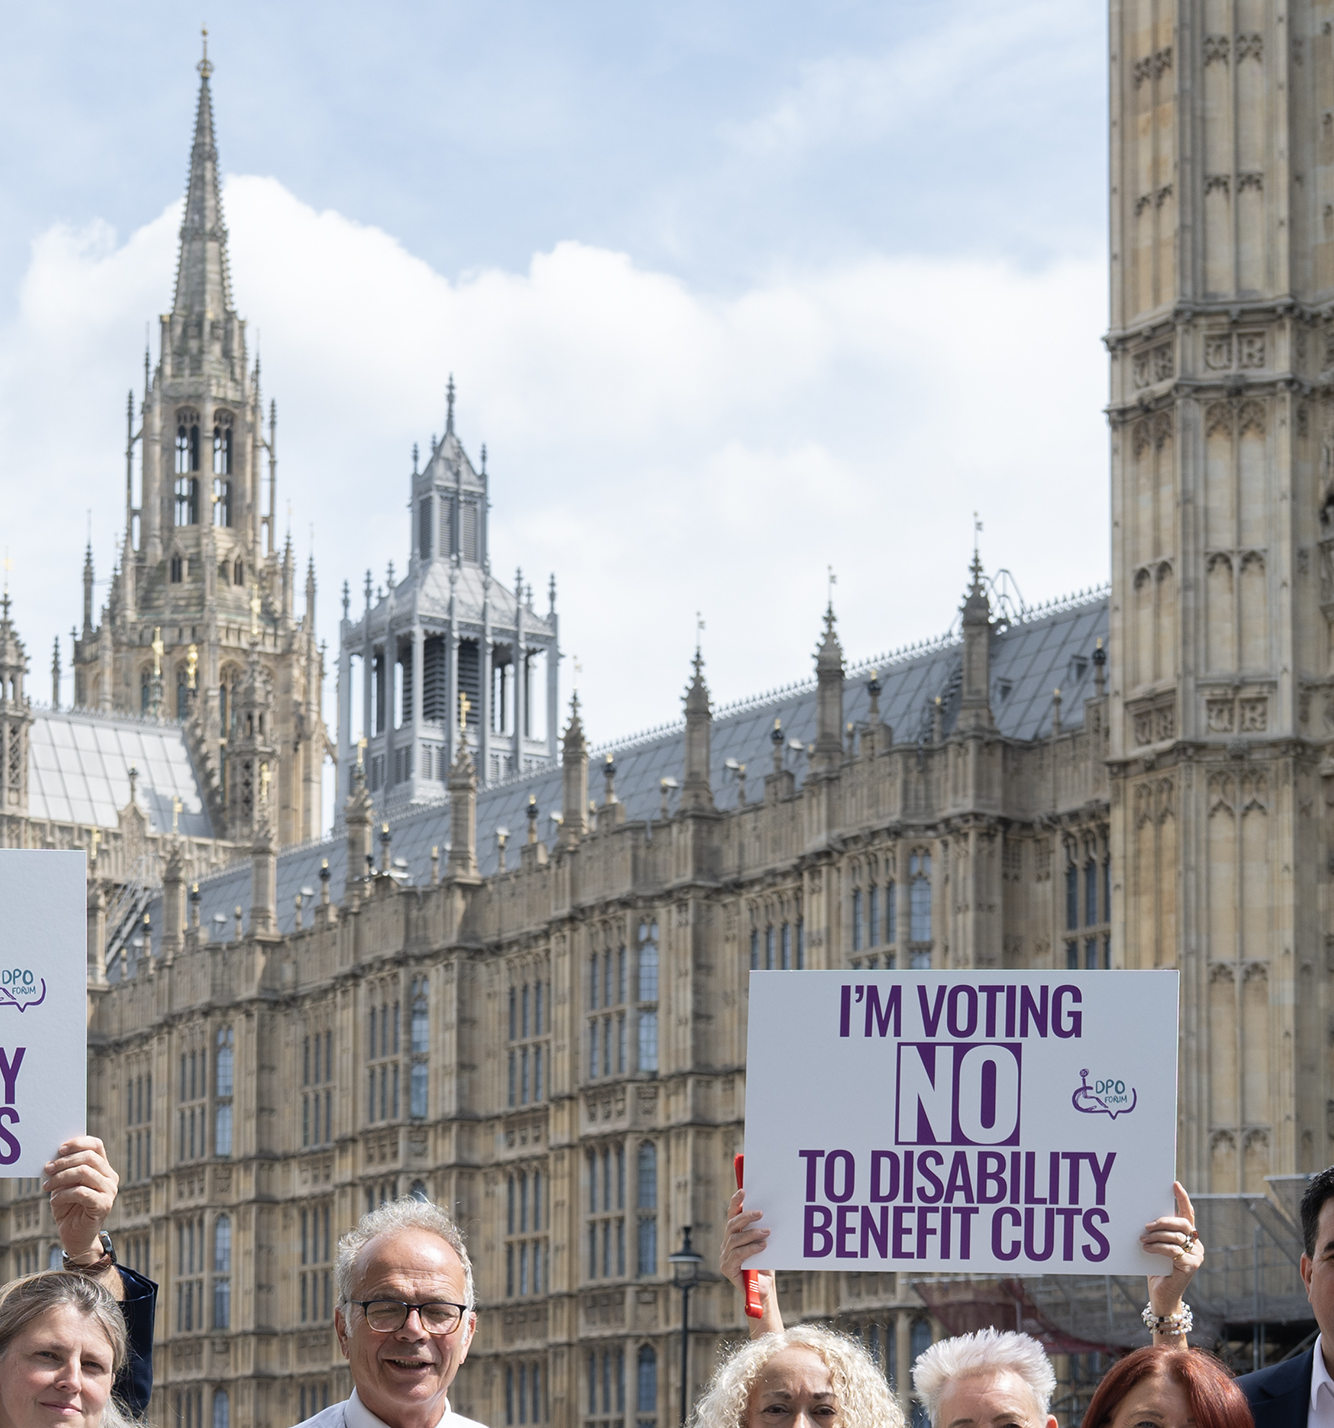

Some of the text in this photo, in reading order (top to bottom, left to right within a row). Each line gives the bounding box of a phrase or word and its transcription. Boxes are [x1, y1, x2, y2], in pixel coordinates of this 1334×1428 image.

[2, 969, 34, 985] DPO
[12, 986, 36, 995] FORUM
[840, 985, 1082, 1038] I'M VOTING
[898, 1045, 1019, 1144] NO
[1096, 1079, 1125, 1094] DPO
[1104, 1095, 1128, 1104] FORUM
[799, 1149, 1116, 1206] TO DISABILITY
[803, 1206, 1110, 1262] BENEFIT CUTS
